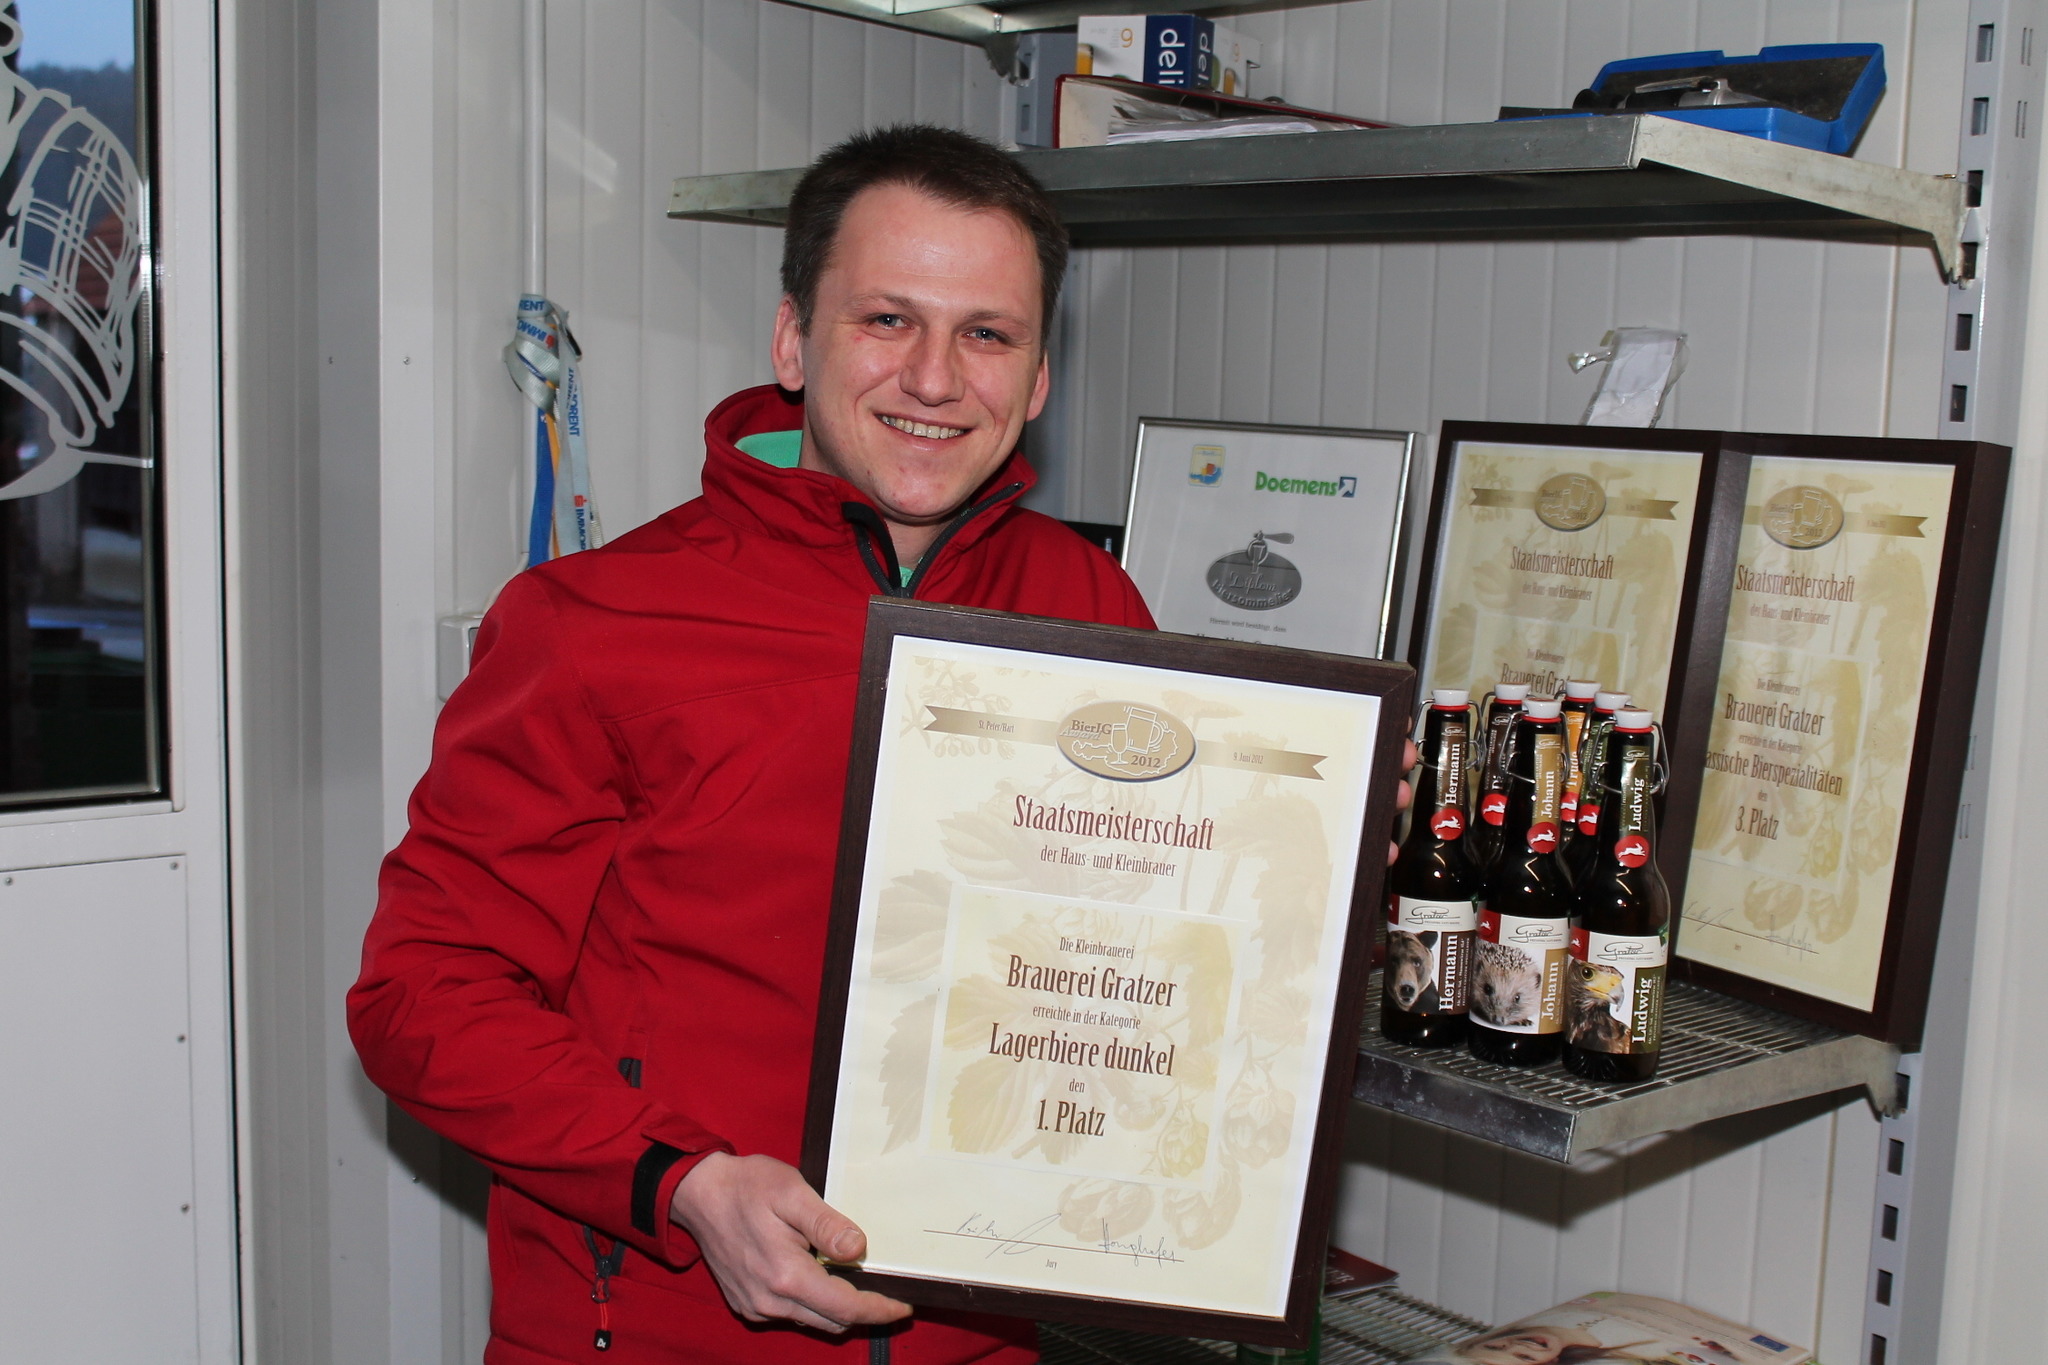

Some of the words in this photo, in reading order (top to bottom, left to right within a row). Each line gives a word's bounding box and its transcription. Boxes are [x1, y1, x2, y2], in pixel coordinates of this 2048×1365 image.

[1158, 28, 1186, 85] deli
[1198, 32, 1211, 86] del
[1255, 471, 1339, 496] Doemens
[573, 509, 586, 550] IMMOR
[1510, 546, 1615, 580] Staatsmeisterschaft
[1736, 565, 1855, 602] Staatsmeisterschaft
[1725, 694, 1777, 728] Brauerei
[1779, 703, 1825, 736] Gratzer
[1131, 754, 1162, 769] 2012
[1444, 743, 1461, 805] Hermann
[1706, 749, 1750, 777] assische
[1750, 755, 1843, 796] Bierspezialitäten
[1541, 770, 1555, 818] Johann
[1628, 777, 1645, 832] Ludwig
[1013, 794, 1215, 851] Staatsmeisterschaft
[1735, 806, 1745, 833] 3.
[1748, 808, 1779, 840] Platz
[1040, 845, 1059, 862] der
[1060, 847, 1091, 867] Haus-
[1093, 850, 1113, 870] und
[1115, 853, 1178, 877] Kleinbrauer
[1059, 936, 1074, 953] Die
[1075, 938, 1135, 960] Kleinbrauerei
[1006, 954, 1097, 998] Brauerei
[1100, 968, 1178, 1006] Gratzer
[1438, 934, 1458, 1011] Hermann
[1541, 962, 1559, 1020] Johann
[1033, 1005, 1072, 1022] erreichte
[1073, 1009, 1082, 1023] in
[1083, 1010, 1099, 1025] der
[1100, 1011, 1141, 1030] Kategorie
[1631, 977, 1653, 1043] Ludwig
[989, 1022, 1100, 1067] Lagerbiere
[1104, 1037, 1175, 1076] dunkel
[1069, 1078, 1085, 1093] den
[1037, 1099, 1049, 1131] 1.
[1054, 1101, 1106, 1136] Platz
